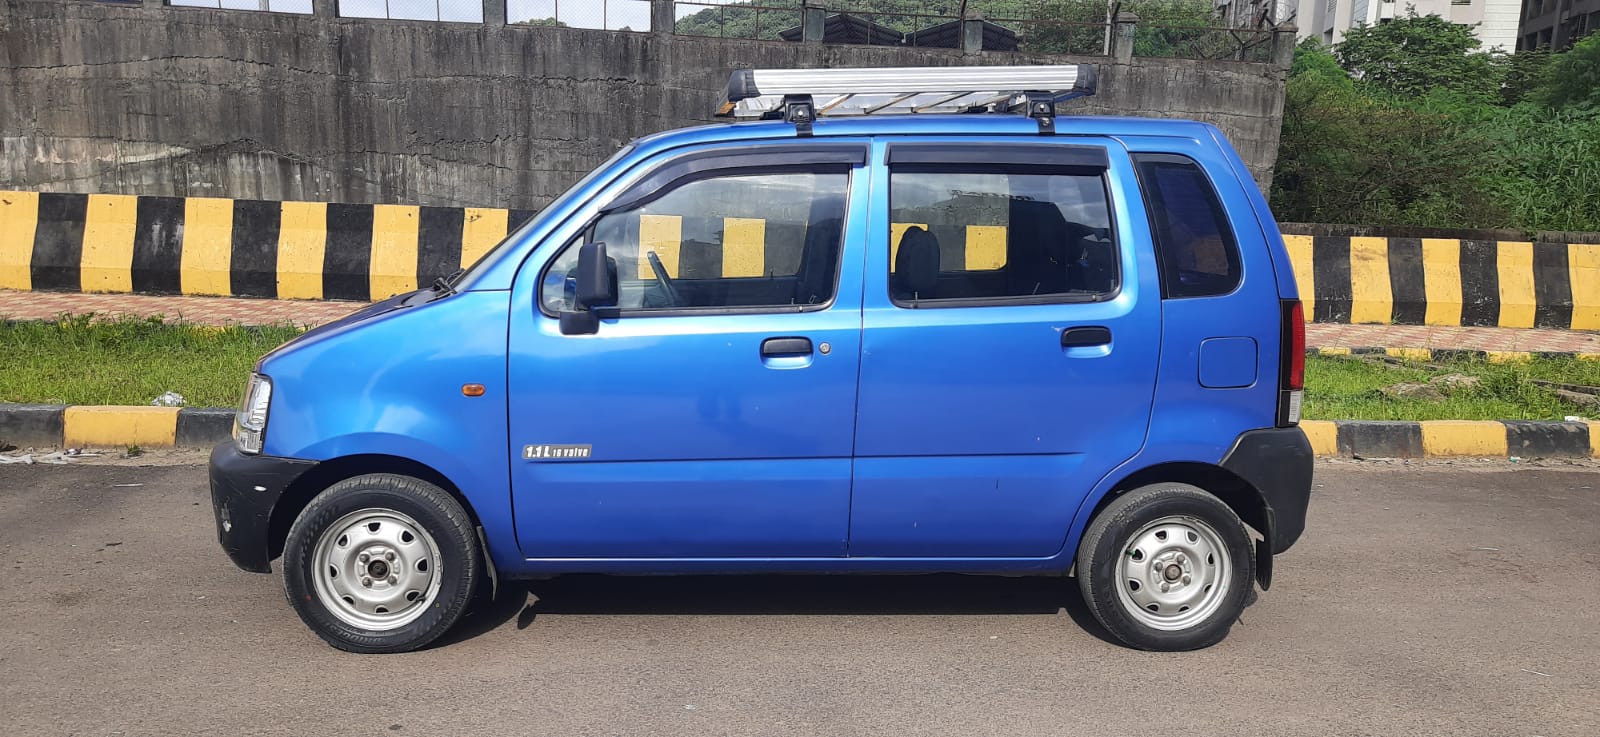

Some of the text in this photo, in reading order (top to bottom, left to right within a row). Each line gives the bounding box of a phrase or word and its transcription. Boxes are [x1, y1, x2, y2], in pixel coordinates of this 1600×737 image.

[526, 445, 588, 458] 1.1 L 16 valve
